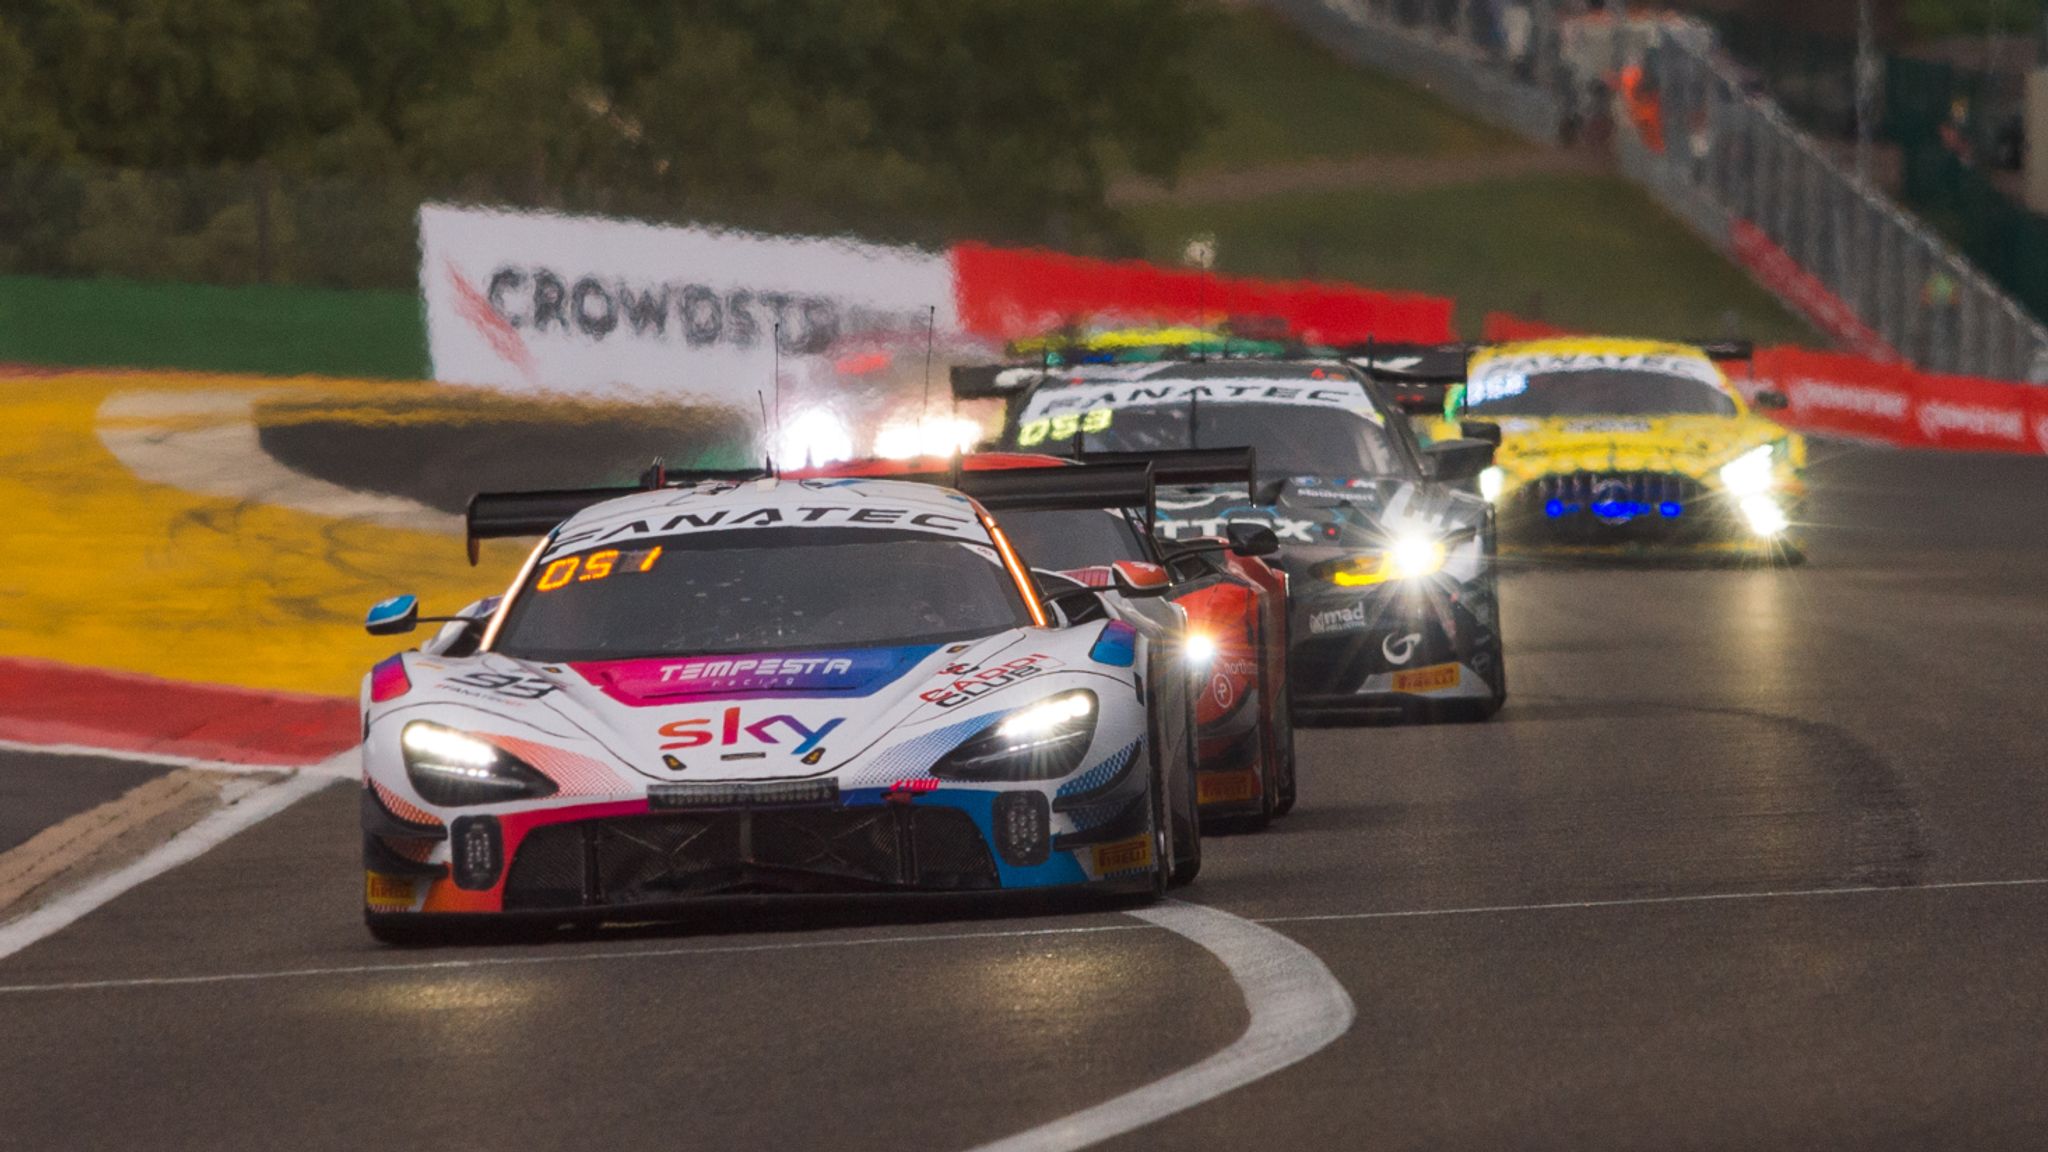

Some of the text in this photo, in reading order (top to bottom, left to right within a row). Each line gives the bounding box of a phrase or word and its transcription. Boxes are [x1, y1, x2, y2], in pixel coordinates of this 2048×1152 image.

[1040, 385, 1352, 416] FANATEC
[542, 506, 969, 556] FANATEC
[660, 658, 852, 682] TEMPESTA
[712, 677, 794, 688] racing
[446, 672, 557, 699] 93
[936, 666, 1042, 708] CLUB
[658, 707, 847, 755] sky
[1101, 840, 1147, 868] PIRELLI
